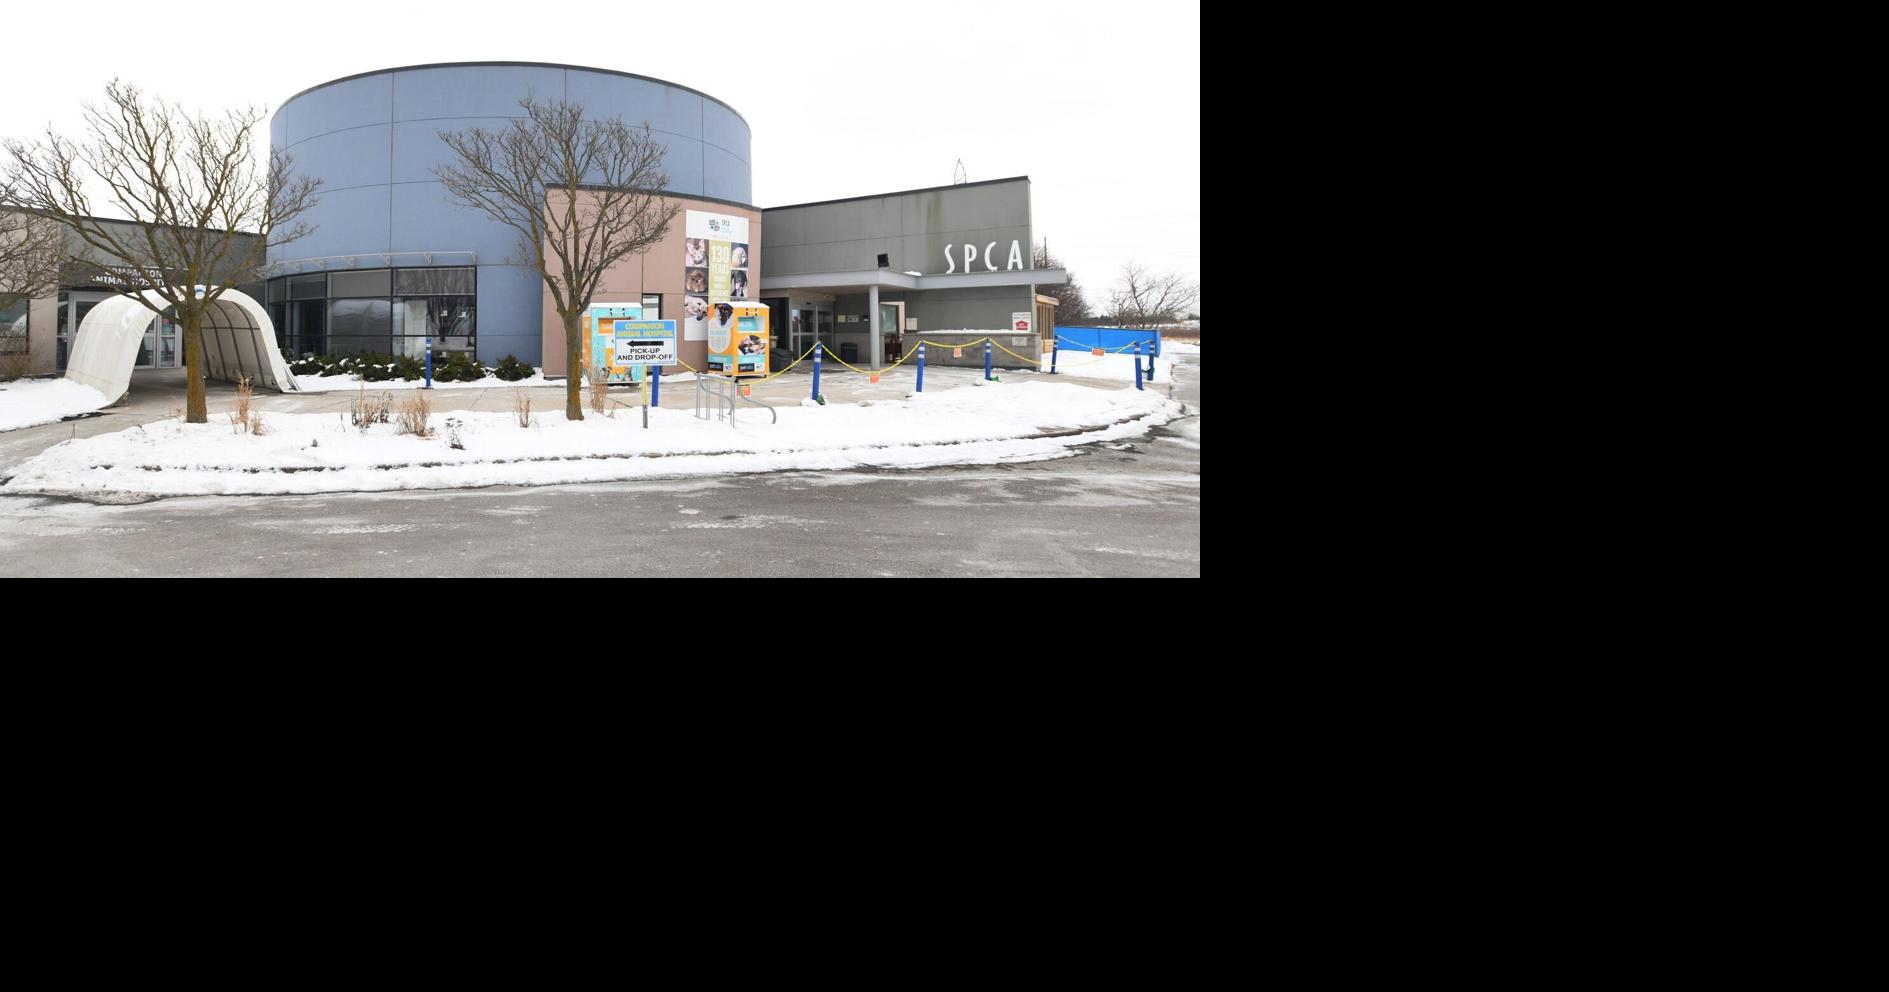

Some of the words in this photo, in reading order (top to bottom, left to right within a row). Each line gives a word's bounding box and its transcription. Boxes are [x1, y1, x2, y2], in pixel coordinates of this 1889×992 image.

[711, 245, 729, 263] 130
[944, 240, 1024, 274] SPCA
[105, 267, 163, 277] OMPAON
[712, 263, 729, 274] YEARS
[90, 275, 128, 286] NIMA
